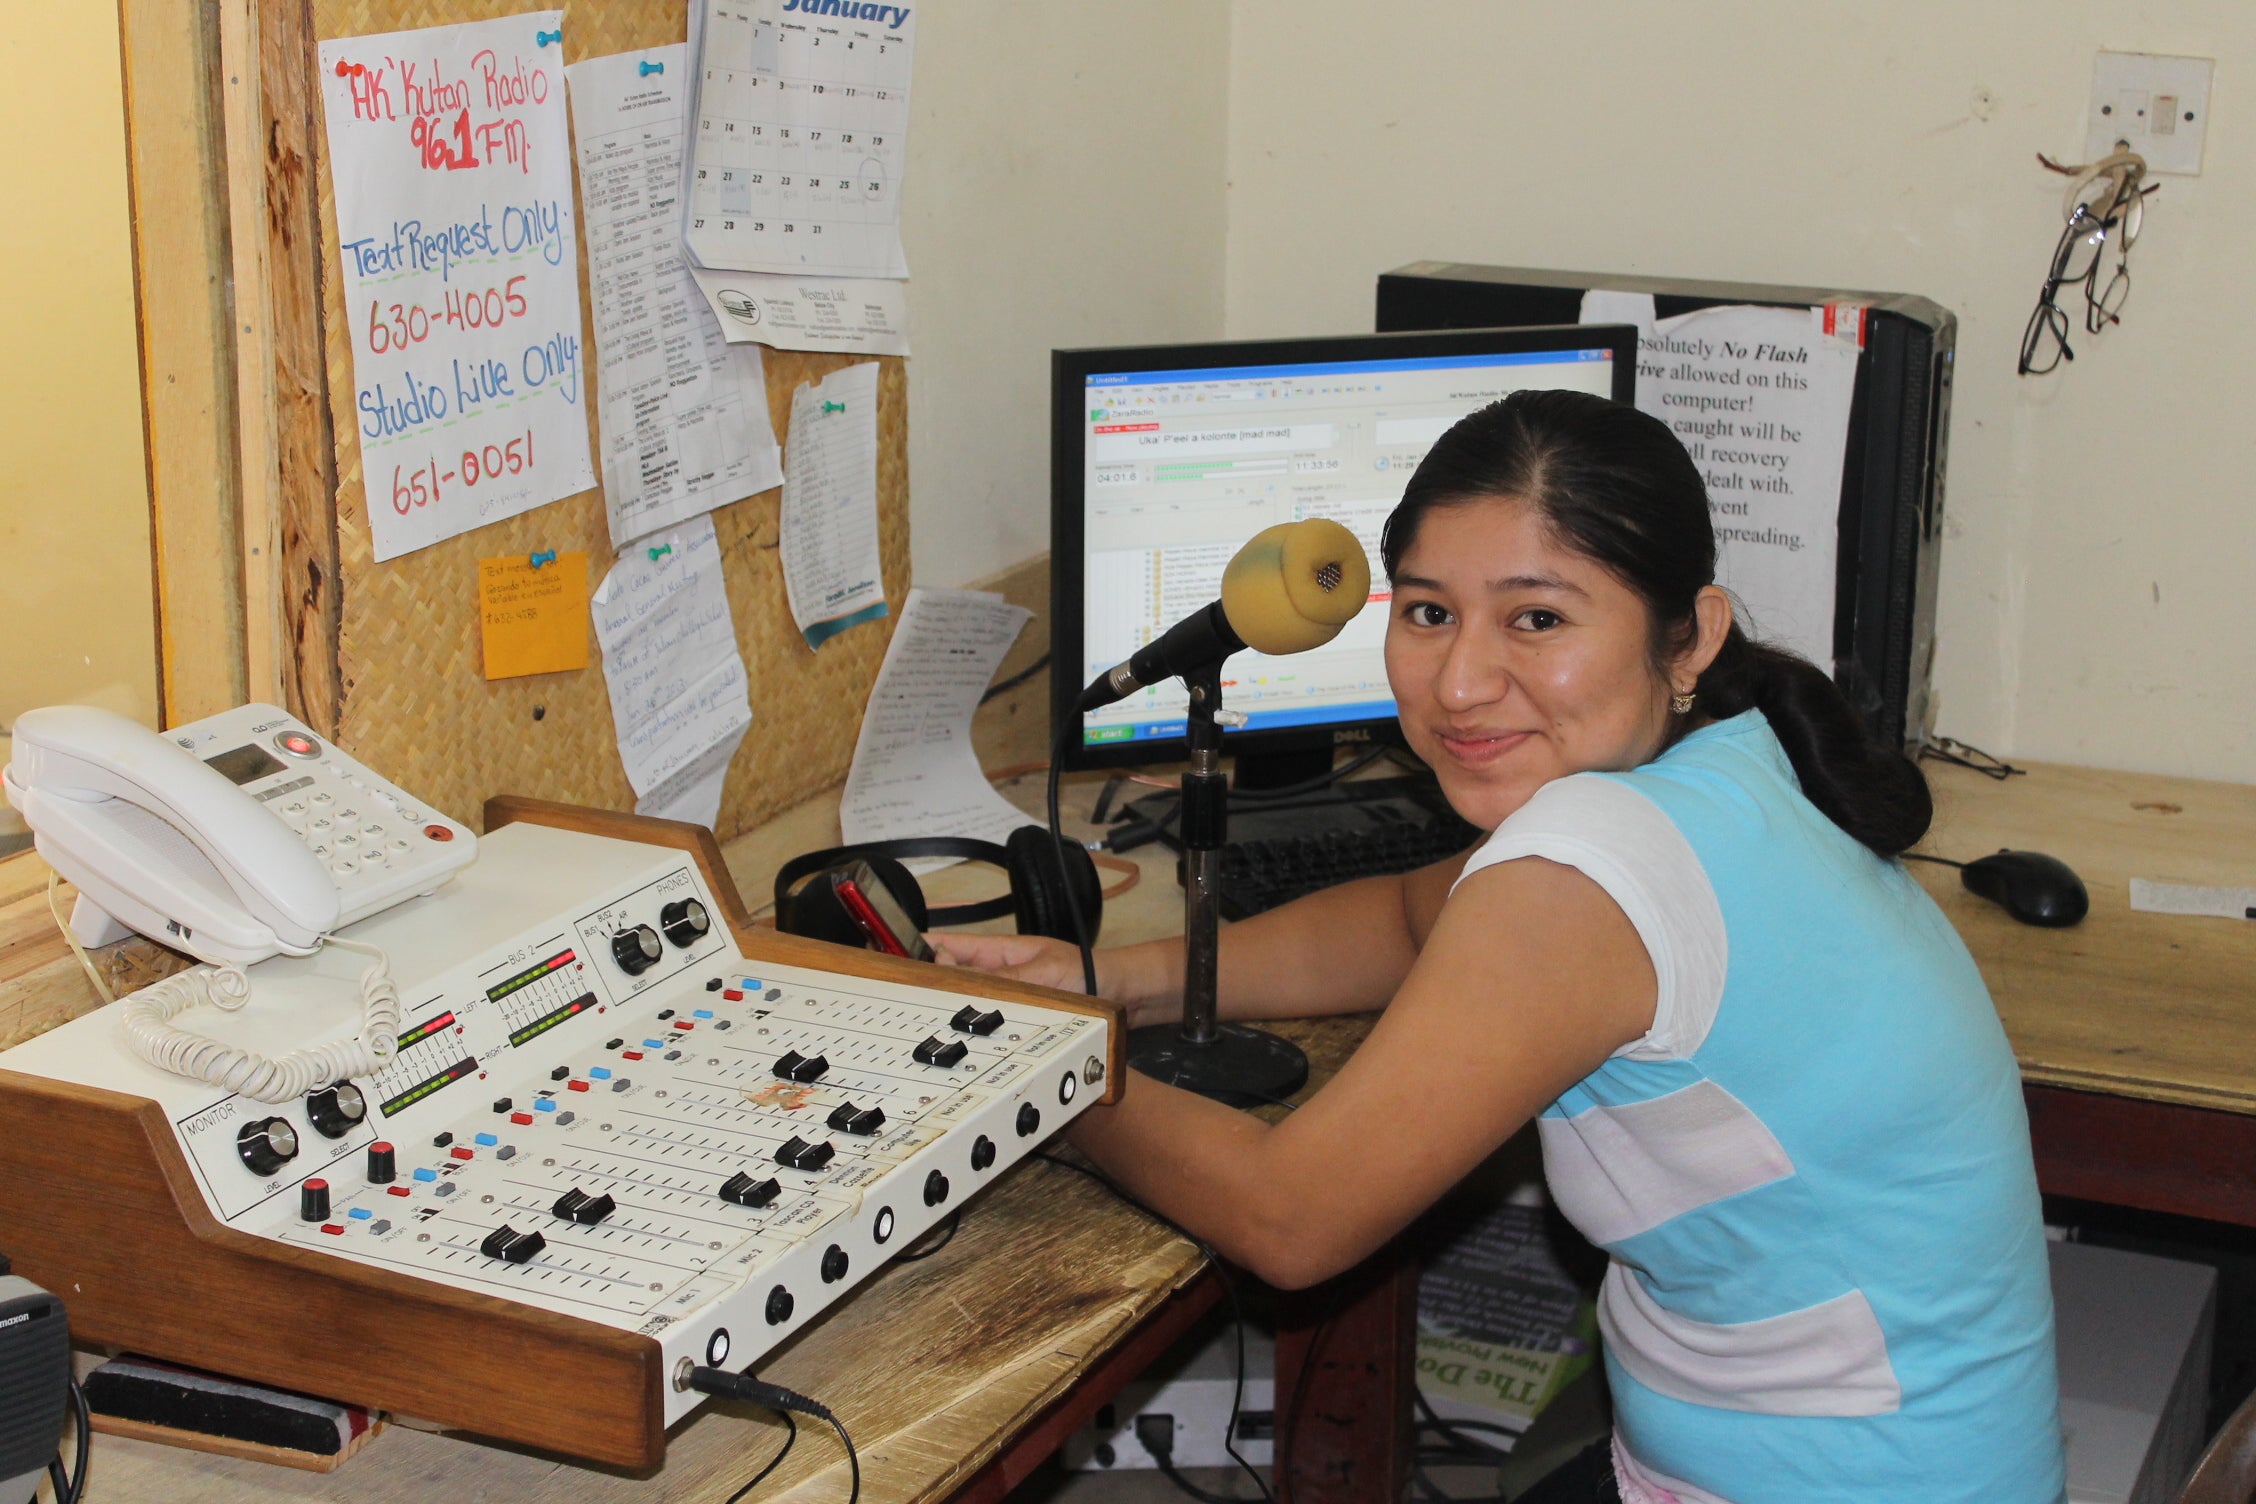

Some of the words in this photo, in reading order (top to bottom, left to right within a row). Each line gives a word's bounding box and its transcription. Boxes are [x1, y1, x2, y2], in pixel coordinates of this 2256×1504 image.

[753, 29, 759, 38] 1
[779, 34, 785, 43] 2
[814, 38, 820, 47] 3
[848, 41, 854, 50] 4
[879, 45, 885, 54] 5
[471, 49, 548, 111] Radio
[707, 71, 712, 79] 6
[727, 74, 733, 83] 7
[752, 78, 757, 87] 8
[779, 81, 785, 90] 9
[812, 85, 824, 94] 10
[846, 88, 856, 97] 11
[876, 91, 887, 100] 12
[410, 108, 480, 171] 96.1
[702, 120, 710, 130] 13
[725, 123, 734, 133] 14
[752, 126, 761, 135] 15
[780, 129, 789, 138] 16
[811, 132, 821, 141] 17
[841, 134, 852, 144] 18
[872, 137, 883, 146] 19
[697, 170, 707, 180] 20
[723, 172, 732, 181] 21
[752, 175, 762, 184] 22
[781, 177, 791, 186] 23
[809, 179, 820, 188] 24
[839, 180, 850, 190] 25
[868, 182, 880, 191] 26
[694, 220, 705, 229] 27
[724, 221, 734, 230] 28
[754, 222, 764, 231] 29
[784, 224, 794, 233] 30
[813, 225, 822, 234] 31
[342, 221, 403, 277] Text
[400, 204, 499, 281] Request
[369, 275, 527, 354] 630-4005
[1720, 341, 1748, 359] No
[1754, 343, 1808, 364] Flash
[1670, 364, 1740, 386] allowed
[1746, 371, 1769, 387] on
[1775, 372, 1808, 391] this
[359, 371, 447, 438] Studio
[453, 359, 514, 413] Live
[1662, 391, 1754, 413] computer!
[1111, 408, 1154, 419] ZaraRadio
[1201, 431, 1236, 442] kolonte
[1239, 429, 1264, 441] [mad
[1266, 428, 1291, 439] mad]
[1673, 418, 1733, 440] caught
[1740, 421, 1774, 441] will
[1781, 424, 1802, 443] be
[1711, 448, 1789, 472] recovery
[392, 429, 534, 515] 651-0051
[1750, 475, 1794, 496] with.
[1715, 526, 1805, 552] spreading.
[1333, 729, 1371, 743] DELL
[656, 872, 690, 896] PHONES
[508, 949, 526, 965] BUS
[527, 945, 536, 956] 2
[683, 953, 697, 965] LEVEL
[632, 979, 648, 992] SELECT
[463, 1000, 478, 1014] LEFT
[485, 1045, 503, 1061] RIGHT
[1004, 1063, 1019, 1072] use
[960, 1095, 974, 1103] use
[186, 1102, 237, 1137] MONITOR
[330, 1141, 350, 1158] SELECT
[853, 1143, 868, 1151] 5
[881, 1129, 915, 1152] Computer
[264, 1181, 282, 1195] LEVEL
[803, 1179, 818, 1188] 4
[800, 1200, 815, 1209] CD
[746, 1217, 763, 1226] 3
[796, 1207, 823, 1225] Player
[689, 1257, 707, 1265] 2
[737, 1253, 757, 1265] Mic
[628, 1300, 645, 1308] 1
[675, 1292, 694, 1305] Mic
[0, 1313, 29, 1329] maxon
[1473, 1367, 1538, 1405] The
